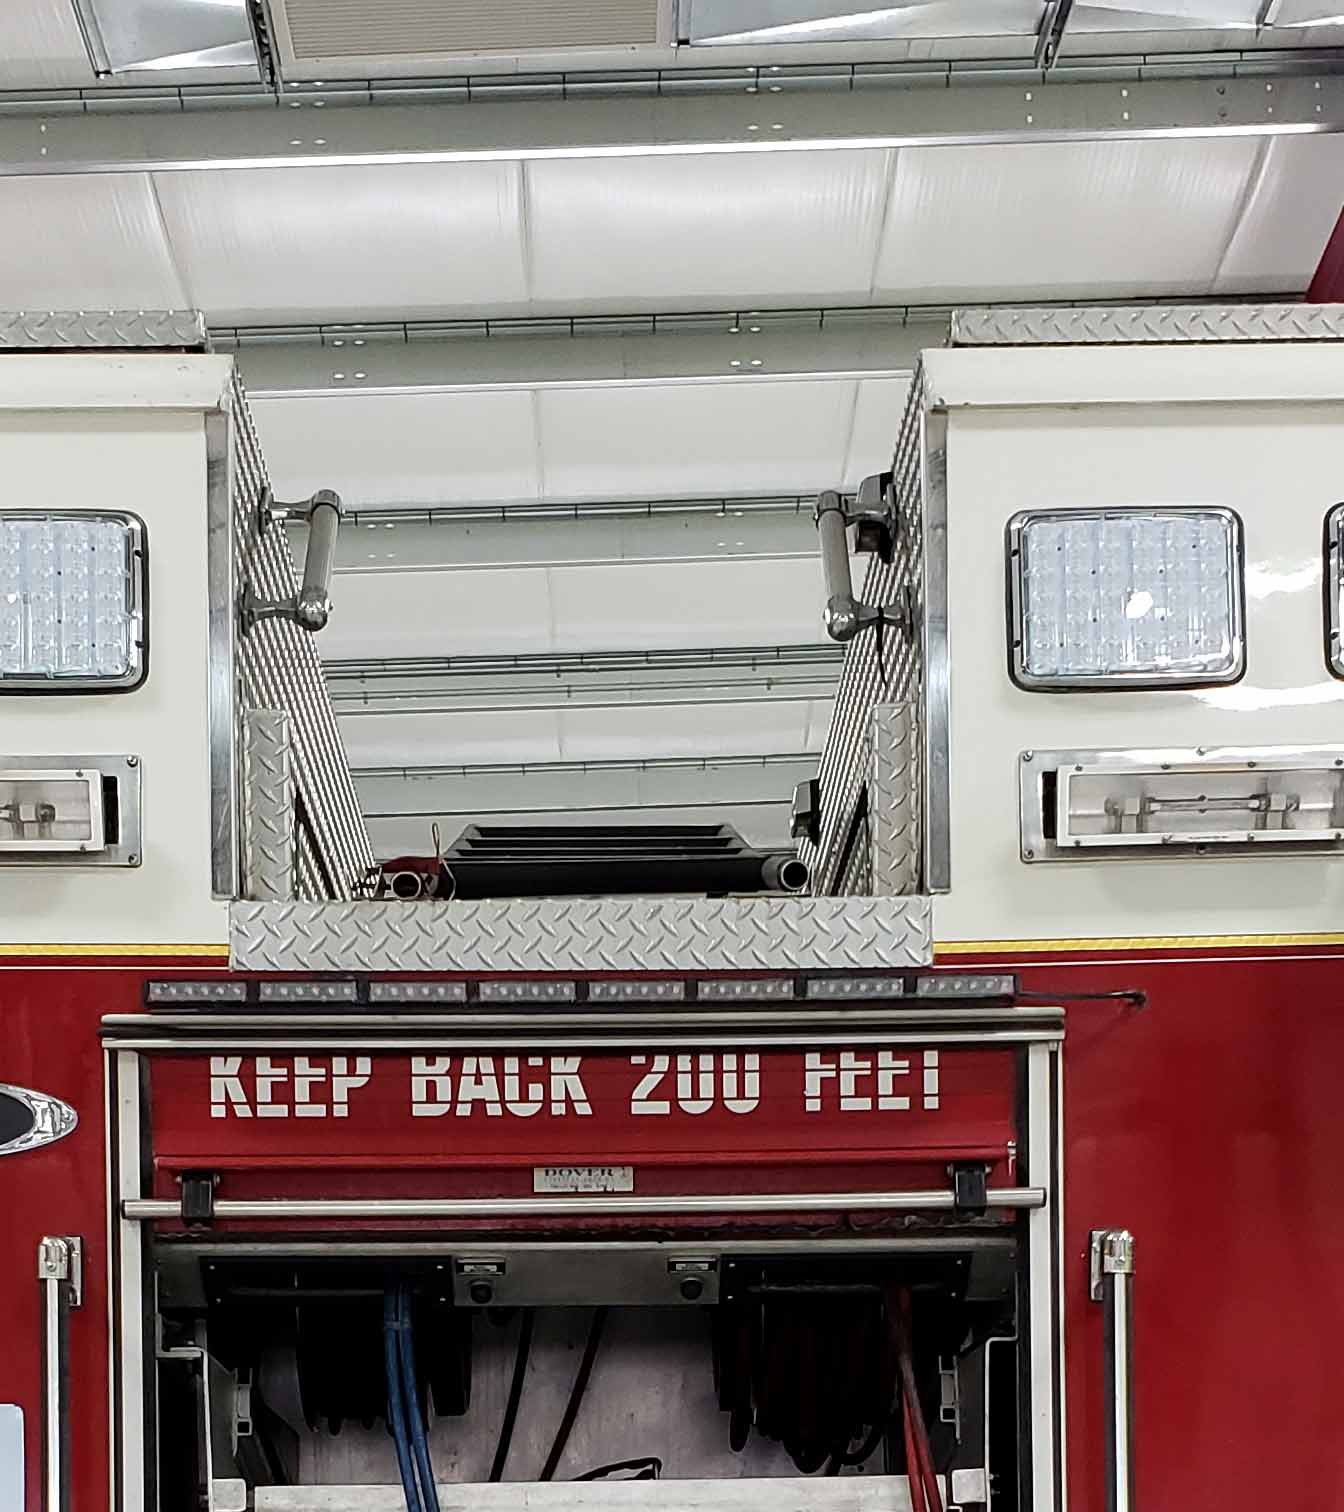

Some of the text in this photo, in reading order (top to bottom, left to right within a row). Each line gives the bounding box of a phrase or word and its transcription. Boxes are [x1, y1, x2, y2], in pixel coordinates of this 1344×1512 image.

[209, 1056, 372, 1118] KEEP
[410, 1055, 593, 1117] BACK
[630, 1052, 760, 1115] 200
[544, 1168, 614, 1177] DOVER
